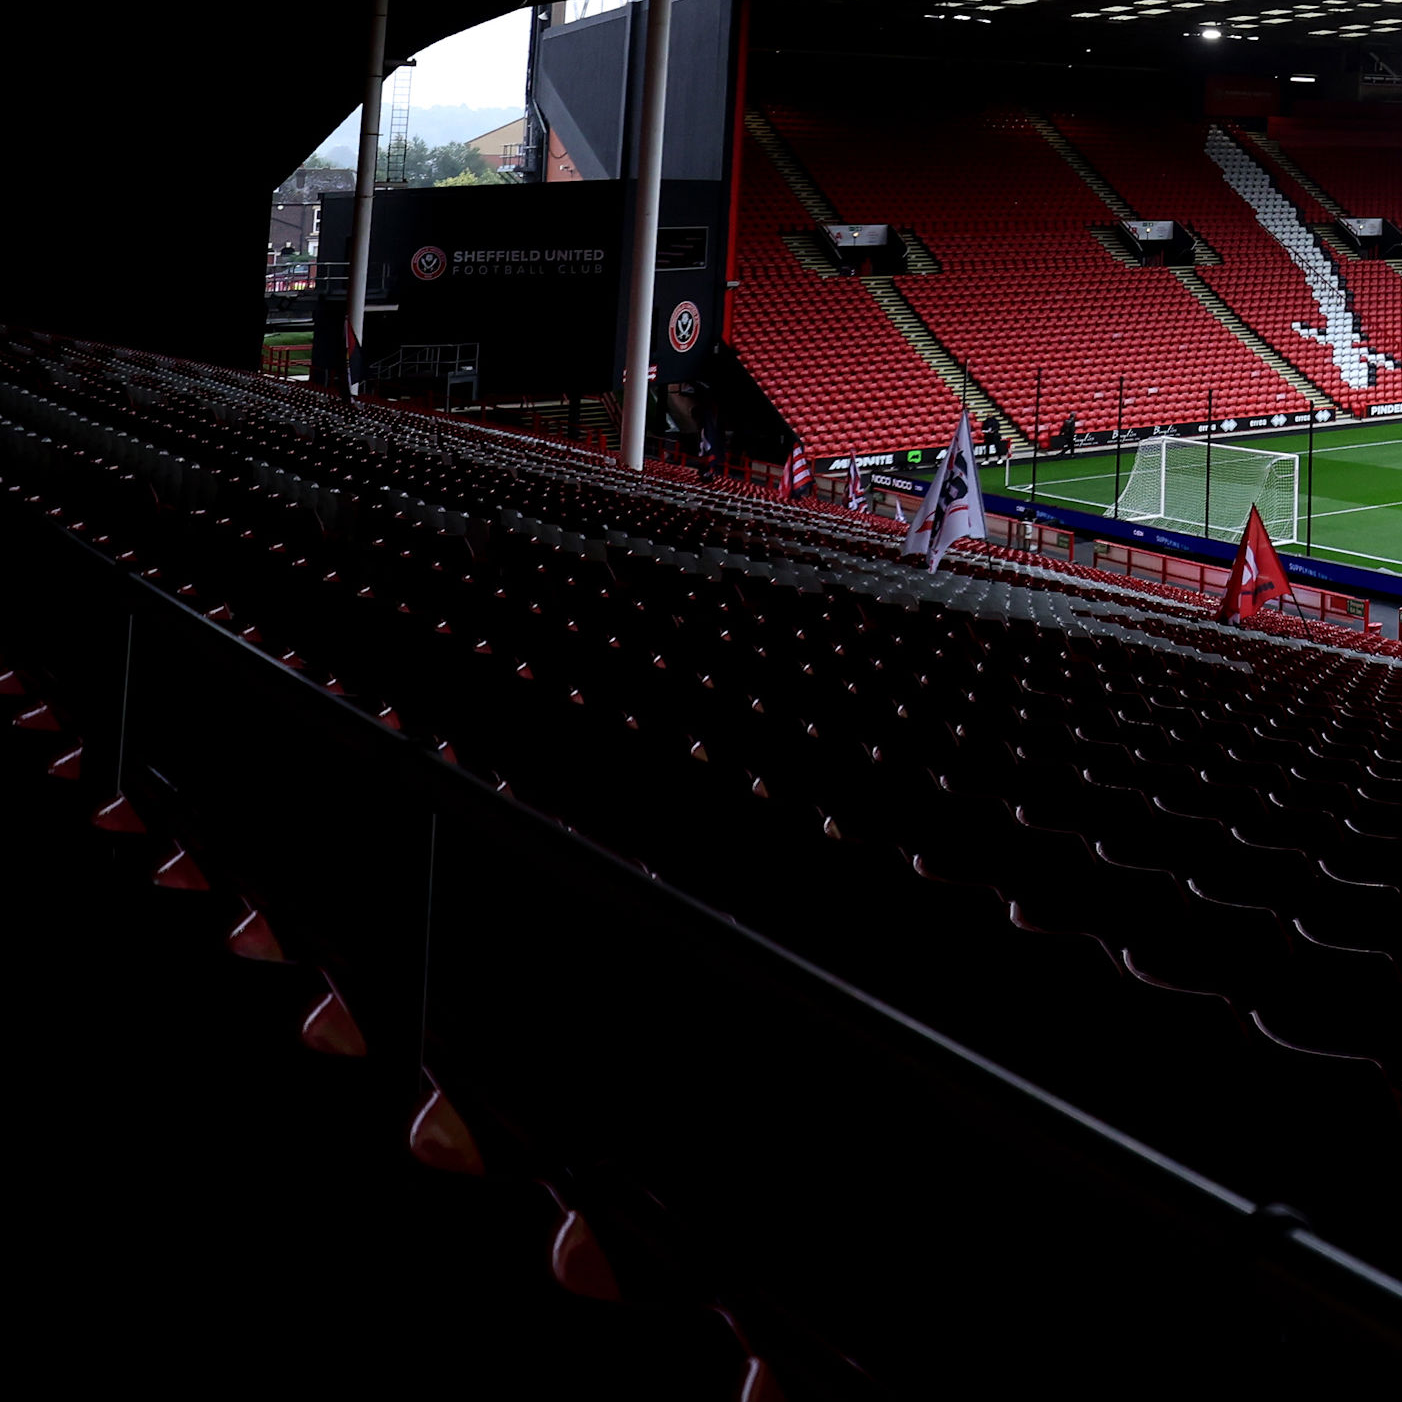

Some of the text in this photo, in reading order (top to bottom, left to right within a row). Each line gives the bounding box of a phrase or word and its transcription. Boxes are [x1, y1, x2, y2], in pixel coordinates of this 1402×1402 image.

[453, 249, 605, 263] SHEFFIELD UNITED
[452, 264, 602, 276] FOOTBALL CLUB
[871, 474, 892, 486] NOCO
[891, 477, 913, 491] NOCO
